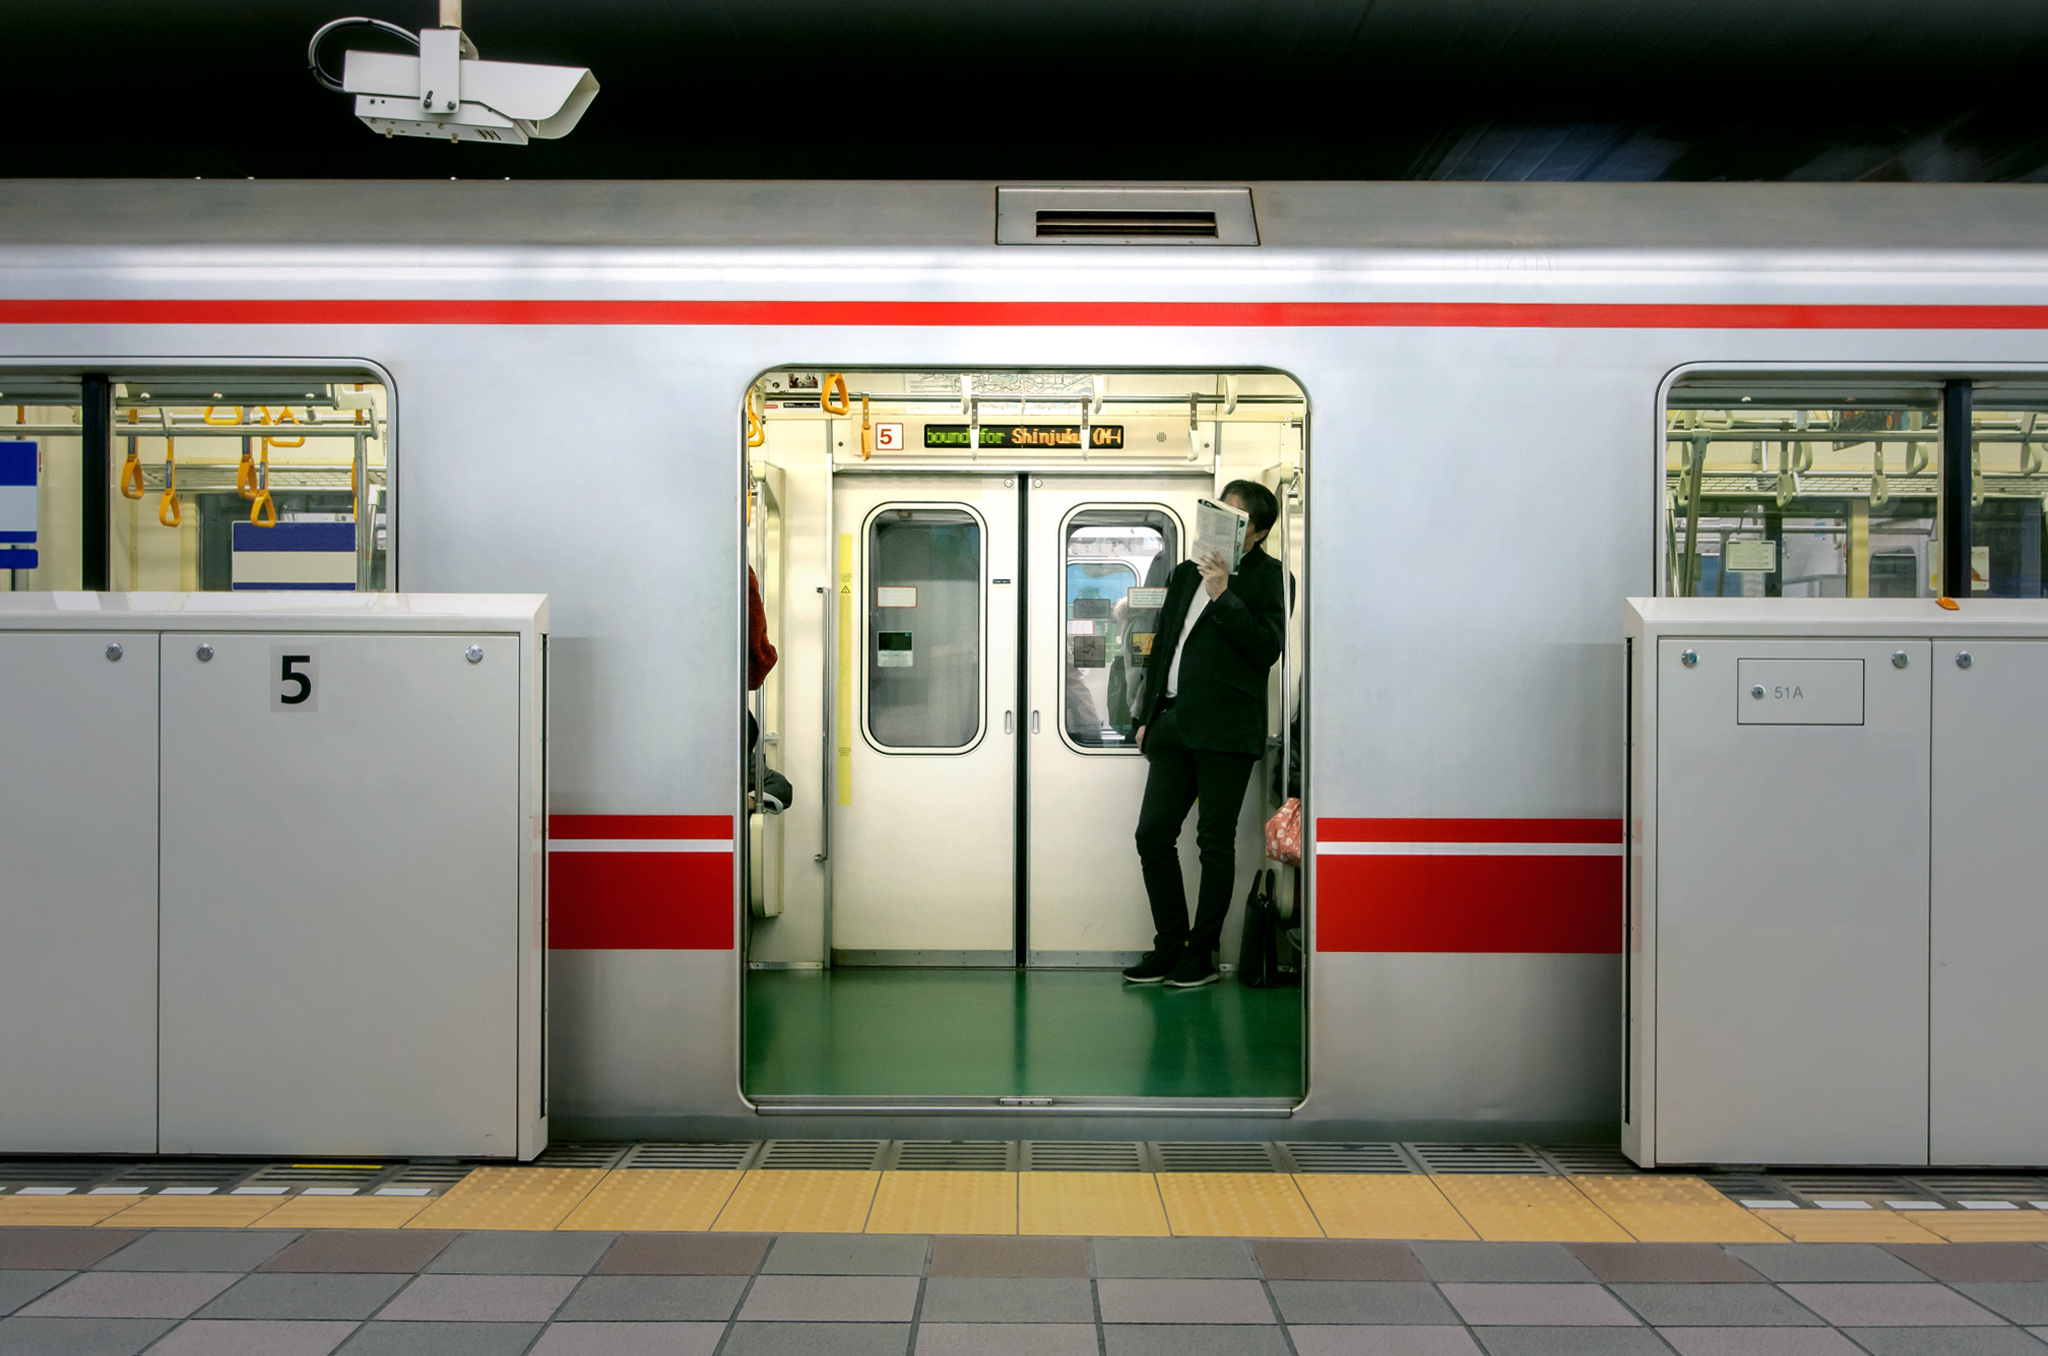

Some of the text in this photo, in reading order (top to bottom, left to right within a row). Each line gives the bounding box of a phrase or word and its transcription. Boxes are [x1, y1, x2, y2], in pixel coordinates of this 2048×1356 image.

[880, 428, 893, 445] 5
[979, 427, 1006, 444] for
[281, 655, 312, 704] 5
[1774, 686, 1803, 699] 51A
